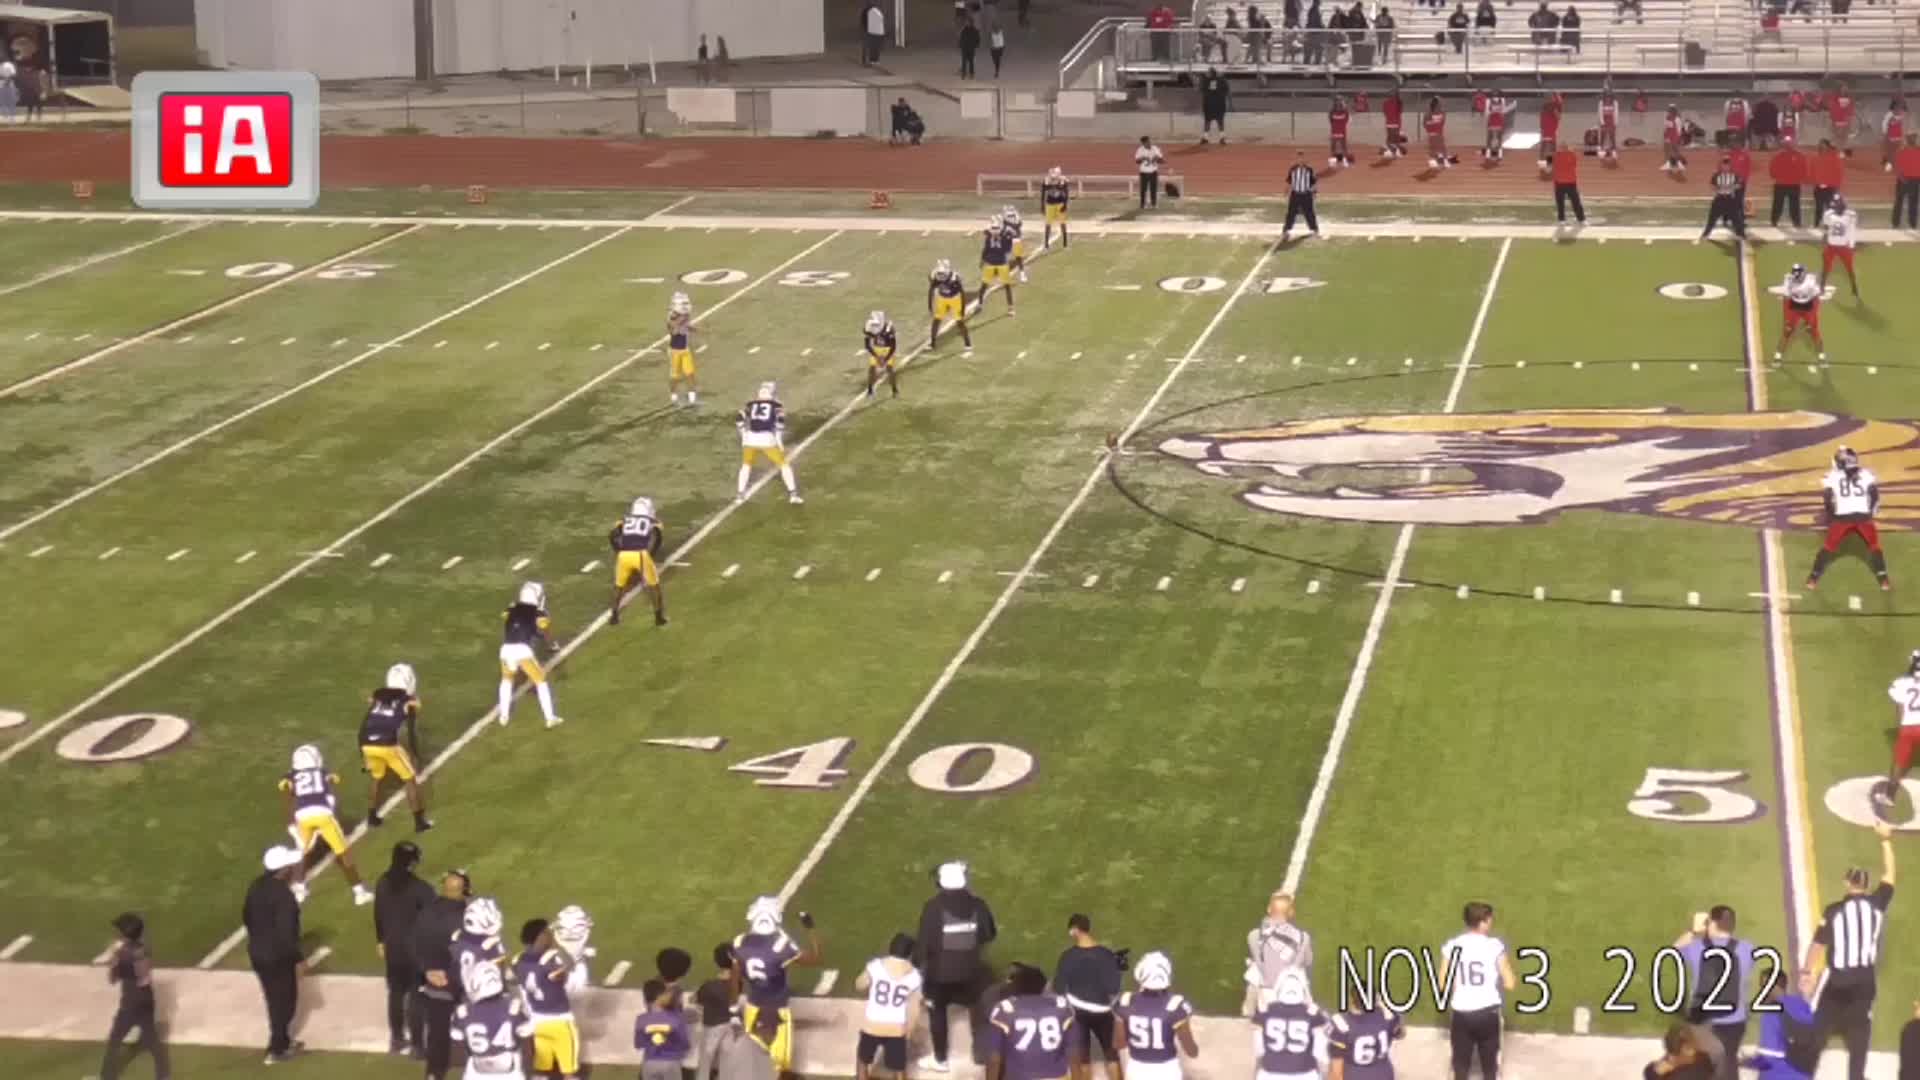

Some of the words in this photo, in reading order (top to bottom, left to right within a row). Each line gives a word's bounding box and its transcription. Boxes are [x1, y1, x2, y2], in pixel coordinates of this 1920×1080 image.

[750, 402, 771, 420] 13
[1839, 477, 1865, 498] 85
[622, 517, 650, 536] 20
[293, 770, 325, 795] 21
[874, 979, 911, 1008] 86
[465, 1020, 515, 1054] 64
[1014, 1016, 1062, 1050] 78
[1128, 1015, 1165, 1050] 51
[1265, 1018, 1310, 1053] 55
[1353, 1030, 1390, 1066] 61
